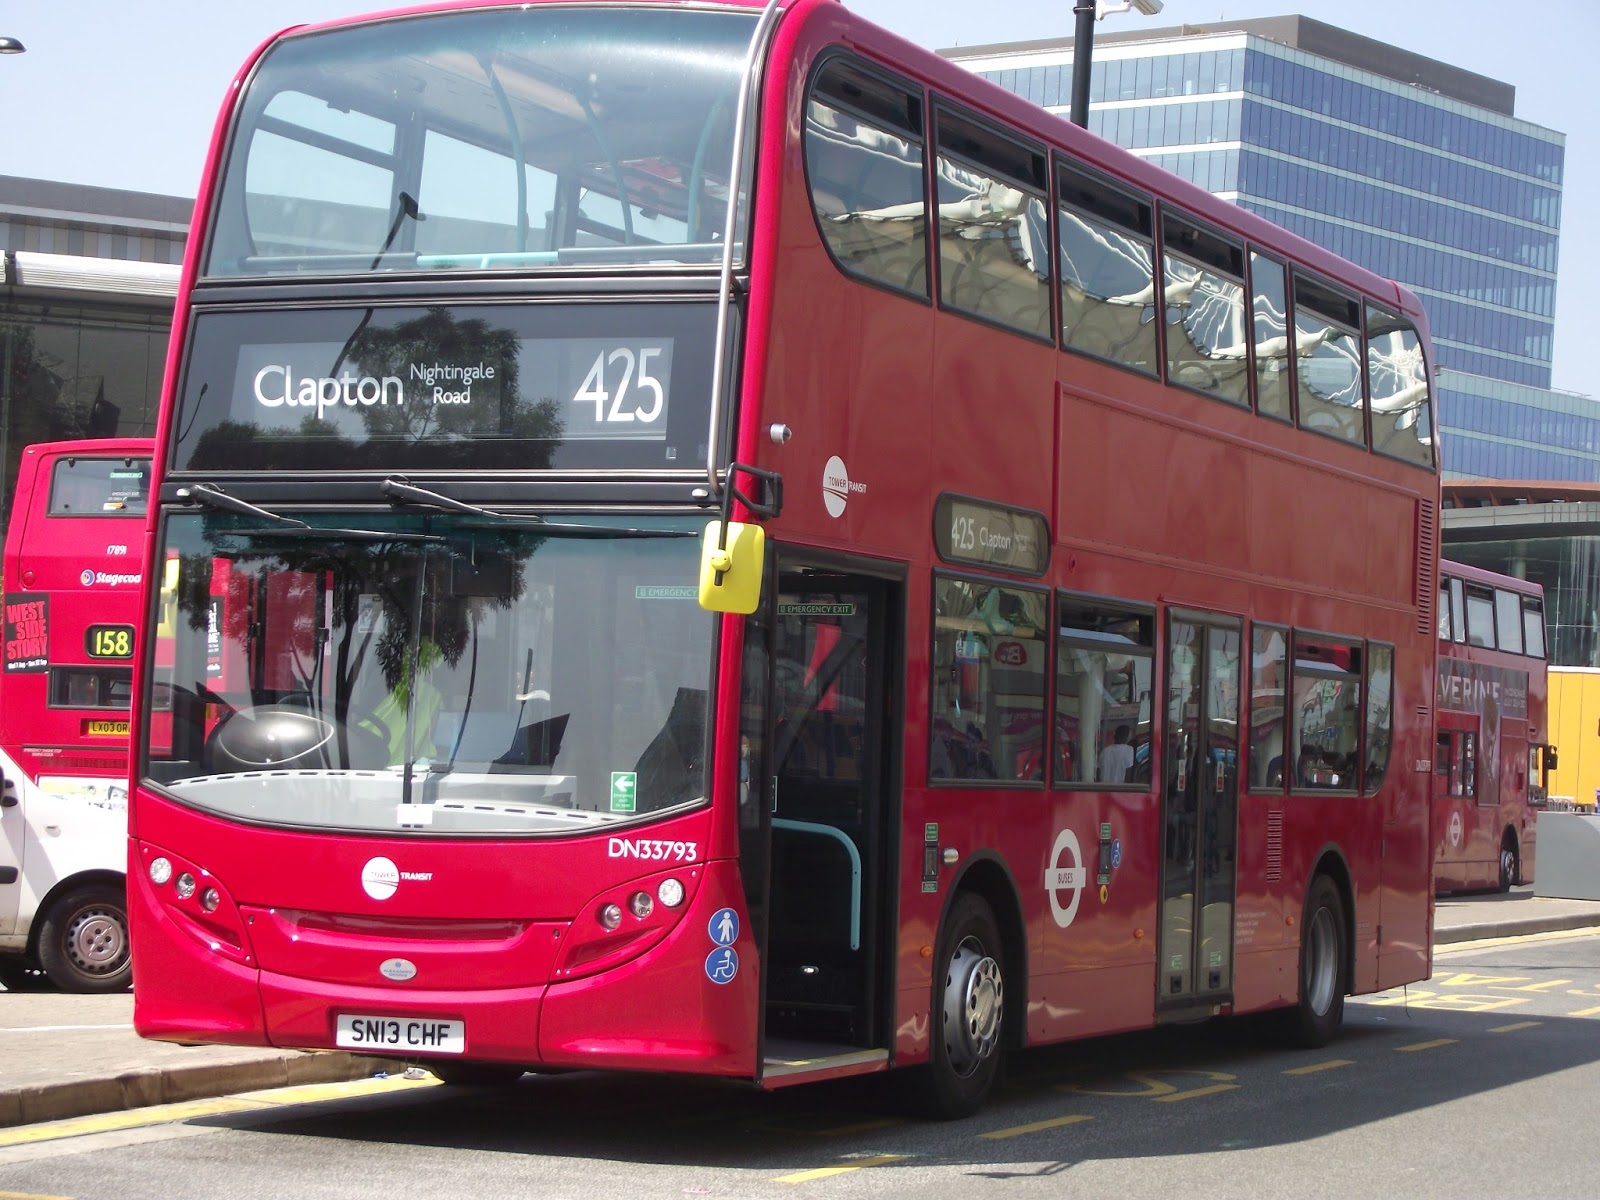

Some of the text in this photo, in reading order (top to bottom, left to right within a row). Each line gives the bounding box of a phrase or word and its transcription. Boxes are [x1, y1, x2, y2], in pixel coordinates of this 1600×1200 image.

[410, 361, 495, 385] Nightingale
[254, 347, 664, 423] Clapton 425
[433, 386, 471, 404] Road
[829, 476, 867, 494] TOWER TRANSIT
[951, 517, 975, 550] 425
[979, 526, 1011, 554] Clapton
[95, 572, 142, 587] Stagecoa
[648, 588, 698, 597] EMERGENCY
[6, 601, 45, 623] WEST
[787, 605, 850, 613] EMERGENCY EXIT
[16, 619, 47, 640] SIDE
[6, 637, 48, 660] STORY
[96, 631, 129, 655] 158
[1438, 673, 1501, 706] VERINE
[92, 722, 130, 733] LX03 OR
[608, 838, 697, 861] DN33793
[400, 872, 433, 881] TRANSIT
[1057, 872, 1074, 884] BUSES
[351, 1019, 450, 1046] SN13 CHF
